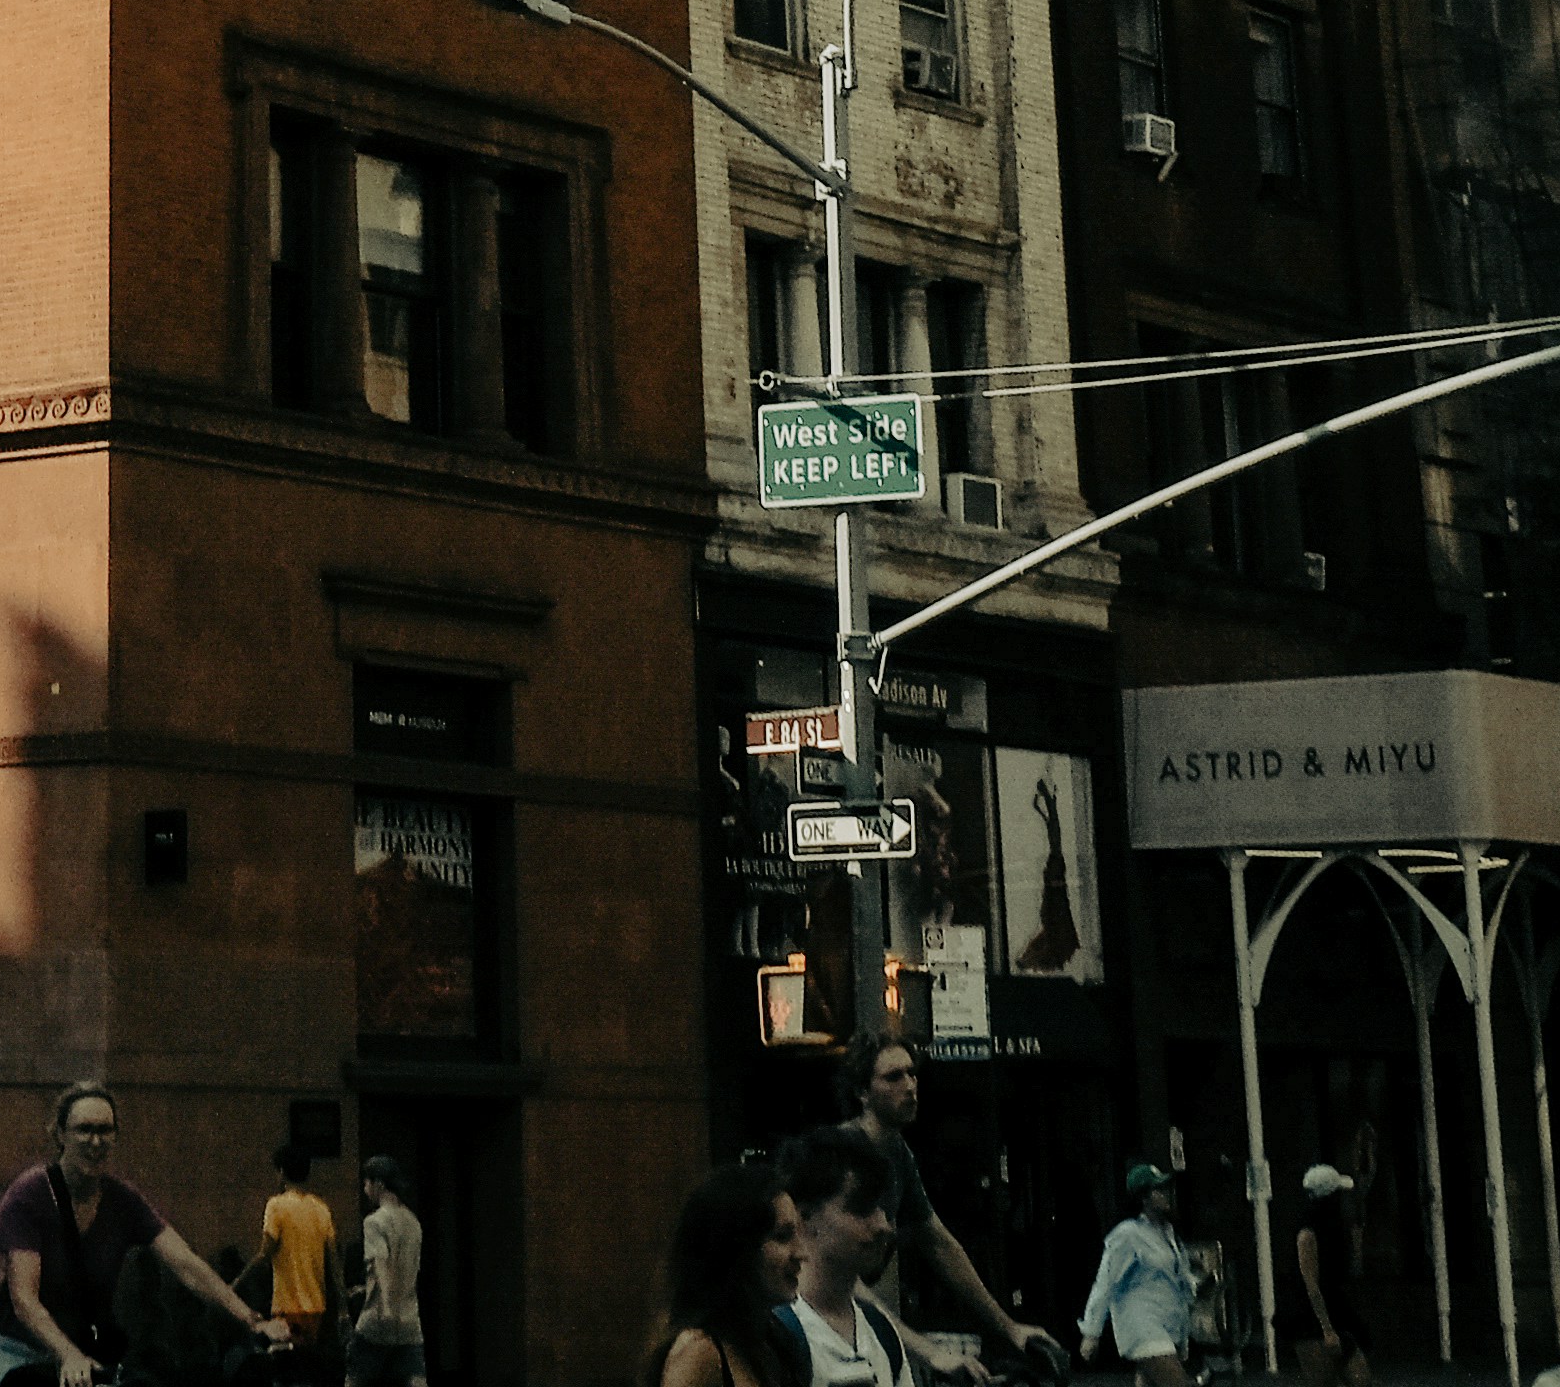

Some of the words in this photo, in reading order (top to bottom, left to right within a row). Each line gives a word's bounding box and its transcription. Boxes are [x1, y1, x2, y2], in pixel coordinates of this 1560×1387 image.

[773, 419, 839, 449] West
[848, 414, 908, 444] Side
[774, 455, 840, 485] KEEP
[850, 452, 910, 480] LEFT
[880, 677, 927, 706] adison
[1159, 750, 1282, 782] ASTRID
[1303, 747, 1325, 777] &
[1346, 744, 1435, 774] MIYU
[801, 820, 836, 842] ONE
